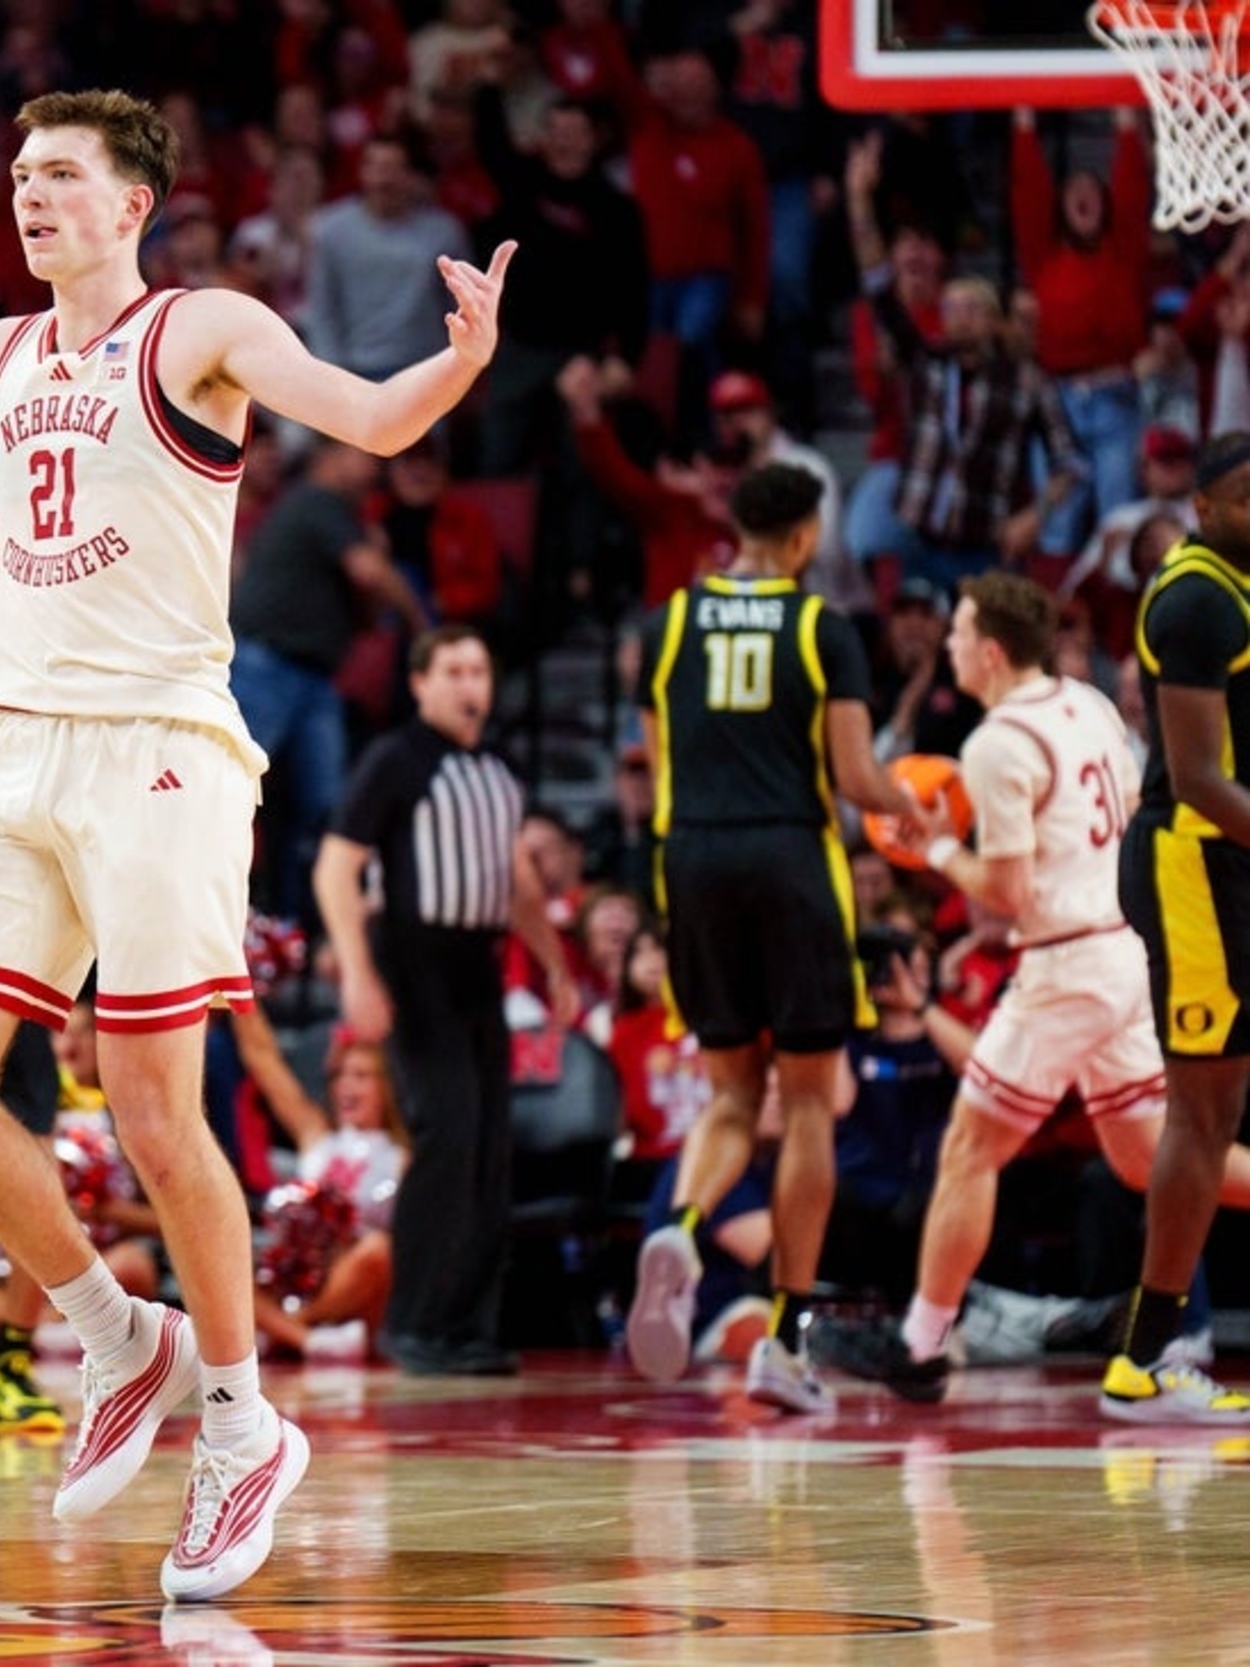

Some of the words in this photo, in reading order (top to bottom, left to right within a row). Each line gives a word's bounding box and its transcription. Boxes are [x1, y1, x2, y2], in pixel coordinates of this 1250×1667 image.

[0, 394, 120, 453] NEBRASKA
[28, 446, 76, 541] 21
[2, 526, 131, 588] CORNHUSKERS
[698, 596, 785, 632] EVANS
[704, 631, 773, 713] 10
[1079, 752, 1125, 849] 31
